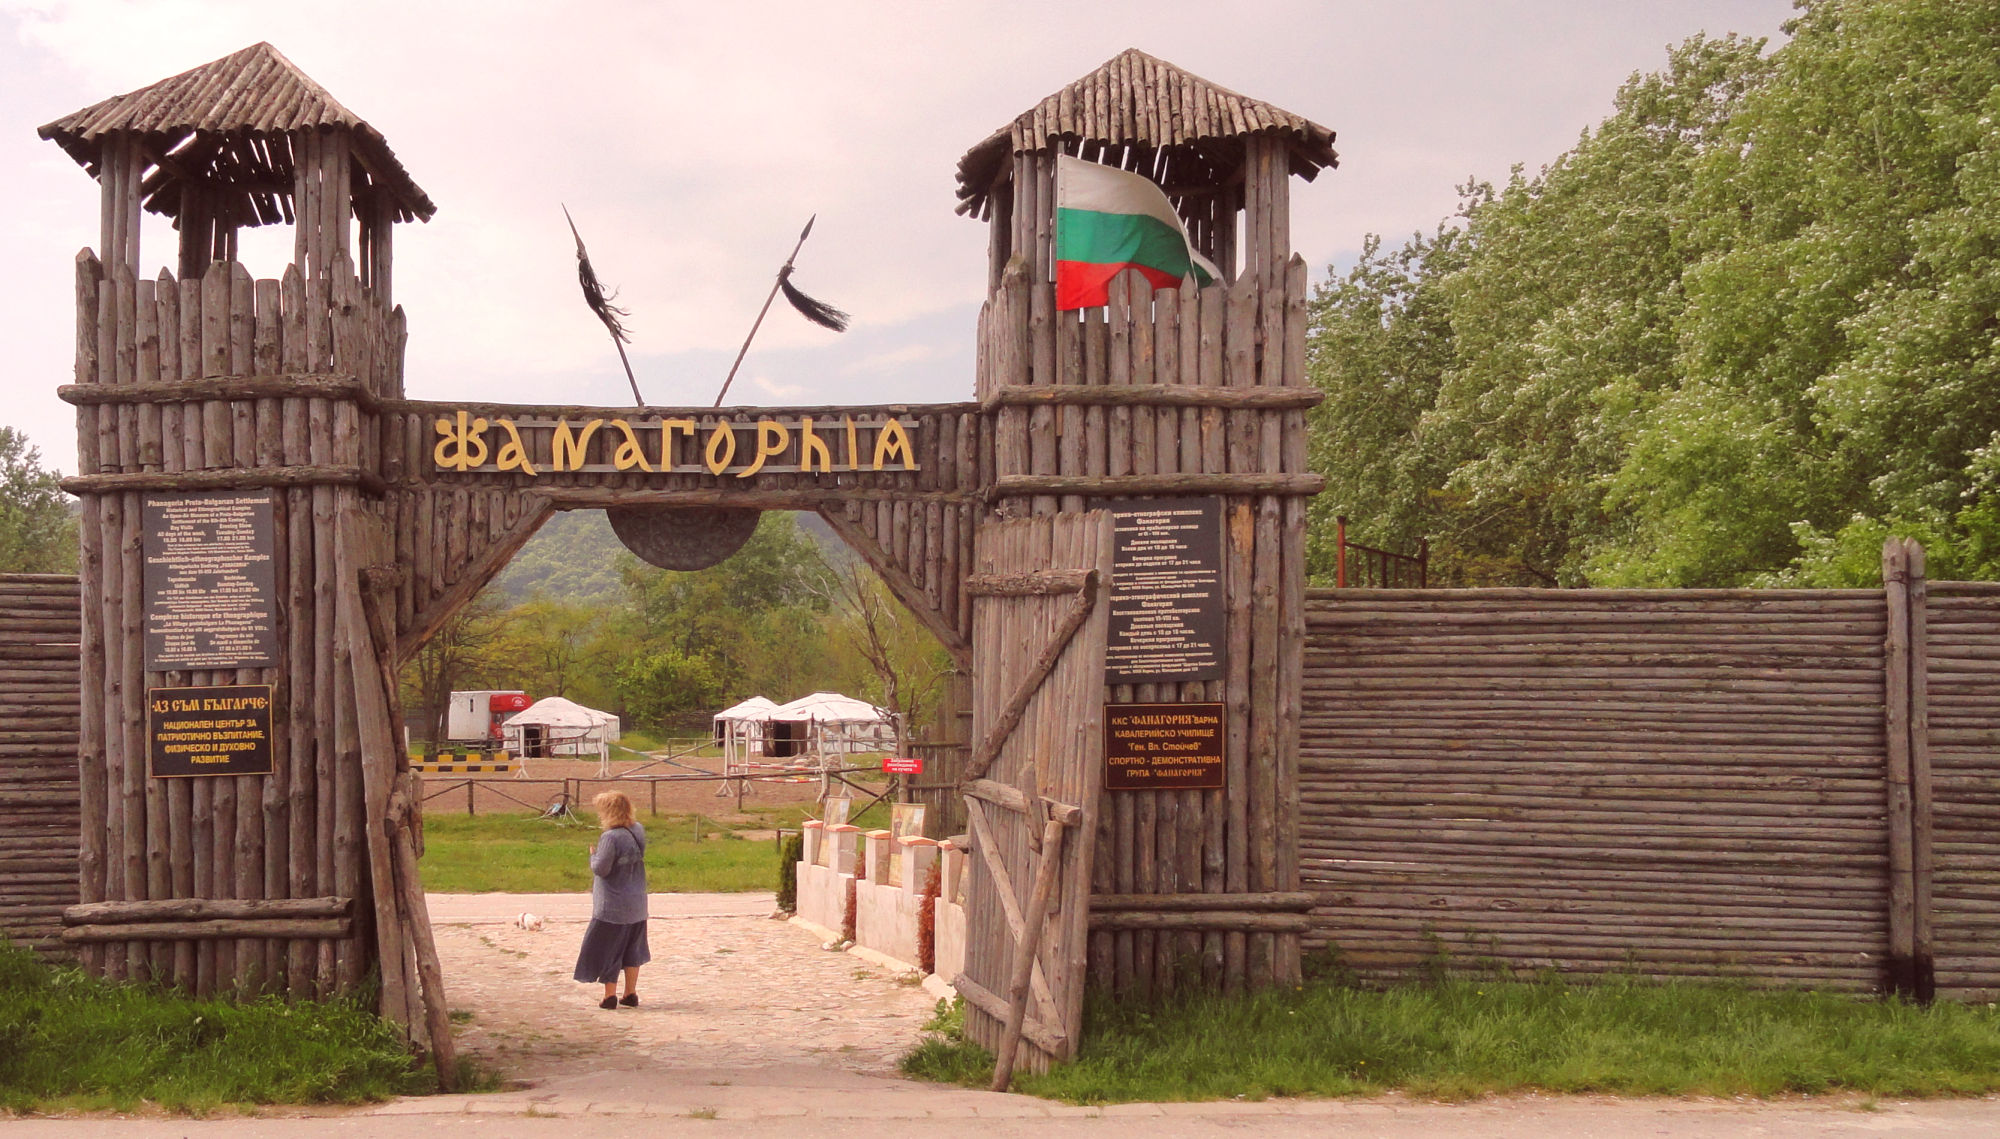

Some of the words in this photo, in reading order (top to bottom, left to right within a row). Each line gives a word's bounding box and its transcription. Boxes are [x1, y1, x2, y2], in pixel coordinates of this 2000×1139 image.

[172, 699, 200, 711] СЪМ
[204, 698, 265, 710] БЪЛГАРЧЕ
[164, 720, 213, 730] НАЦИОНАЛЕН
[216, 720, 245, 729] ЦЕНТЪР
[157, 733, 211, 741] ПАТРИОТИЧНО
[1115, 729, 1175, 737] КАВАЛЕРИЙСКО
[1177, 729, 1214, 737] УЧИЛИЩЕ
[165, 744, 210, 753] ФИЗИЧЕСКО
[219, 743, 256, 752] ДУХОВНО
[191, 755, 230, 764] РАЗВИТИЕ
[1152, 756, 1221, 765] ДЕМОНСТРАТИВНА
